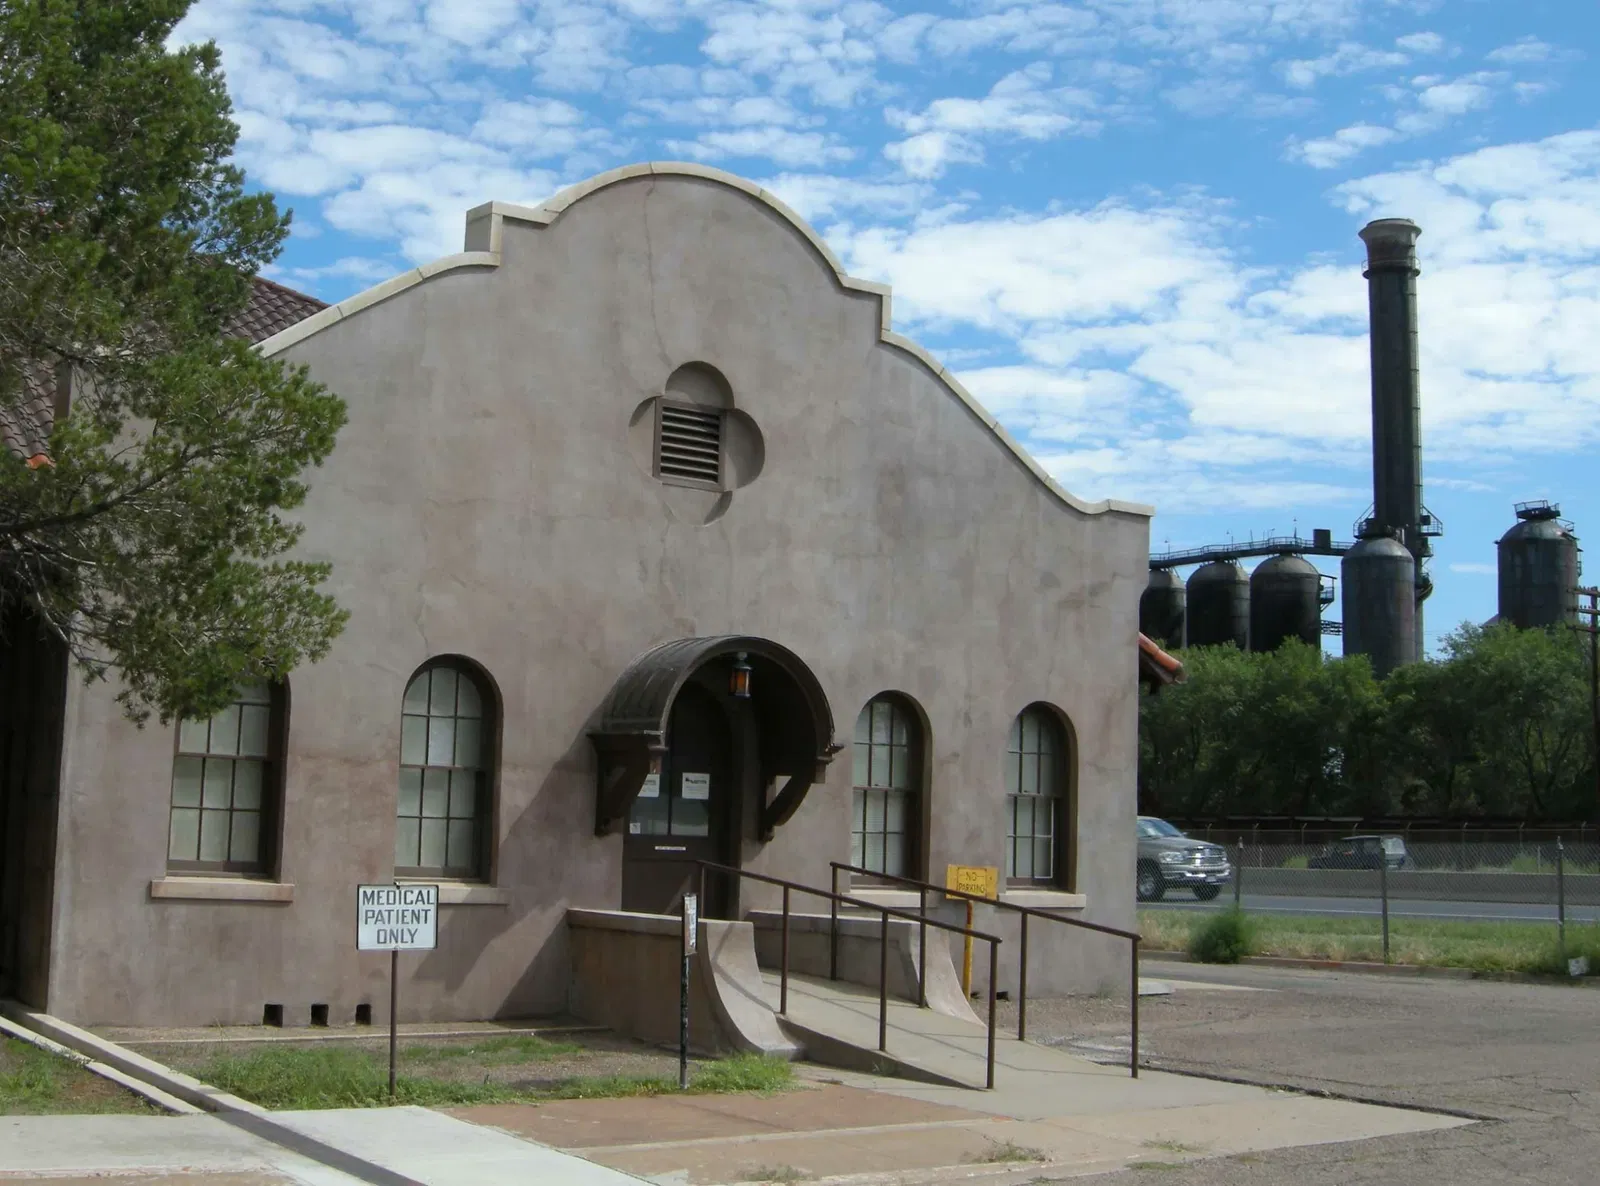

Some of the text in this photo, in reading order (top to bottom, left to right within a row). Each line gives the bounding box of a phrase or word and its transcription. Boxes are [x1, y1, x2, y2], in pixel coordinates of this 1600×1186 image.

[965, 872, 977, 881] NO
[959, 883, 985, 894] PARKING
[362, 890, 434, 905] MEDICAL
[364, 909, 431, 925] PATIENT
[376, 928, 418, 944] ONLY
